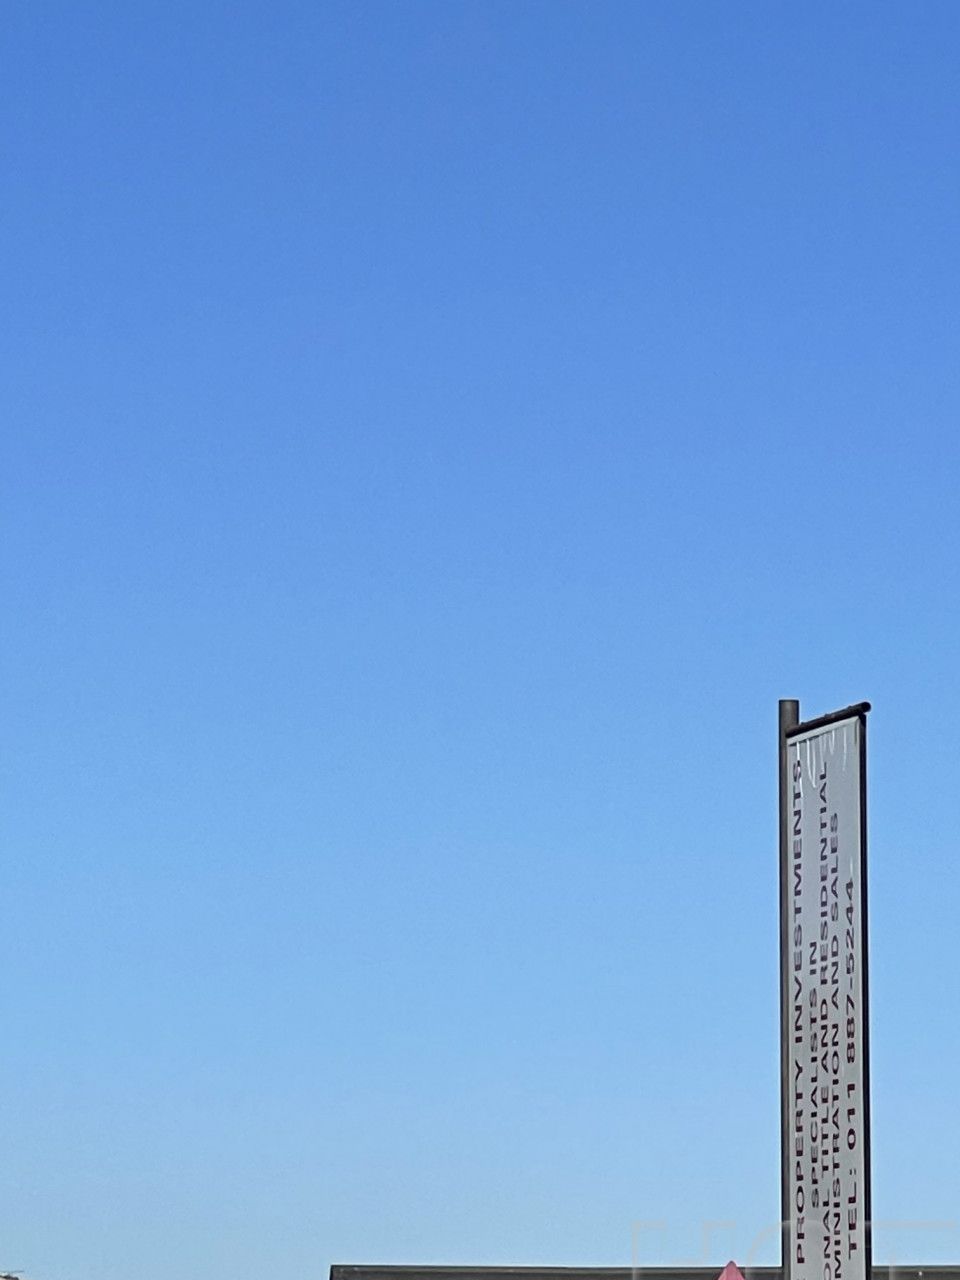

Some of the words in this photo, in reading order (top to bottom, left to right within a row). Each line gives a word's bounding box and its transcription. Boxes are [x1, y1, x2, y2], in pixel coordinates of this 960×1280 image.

[792, 760, 803, 1043] INVESTMENTS
[819, 762, 828, 985] RESIDENTIAL
[830, 813, 839, 922] SALES
[809, 941, 817, 976] IN
[831, 934, 839, 1010] AND
[845, 878, 856, 1063] 887-5244
[820, 998, 829, 1074] AND
[809, 988, 819, 1208] SPECIALISTS
[820, 1086, 829, 1178] TITLE
[847, 1083, 857, 1150] 011
[794, 1059, 805, 1264] PROPERTY
[847, 1168, 858, 1260] TEL:
